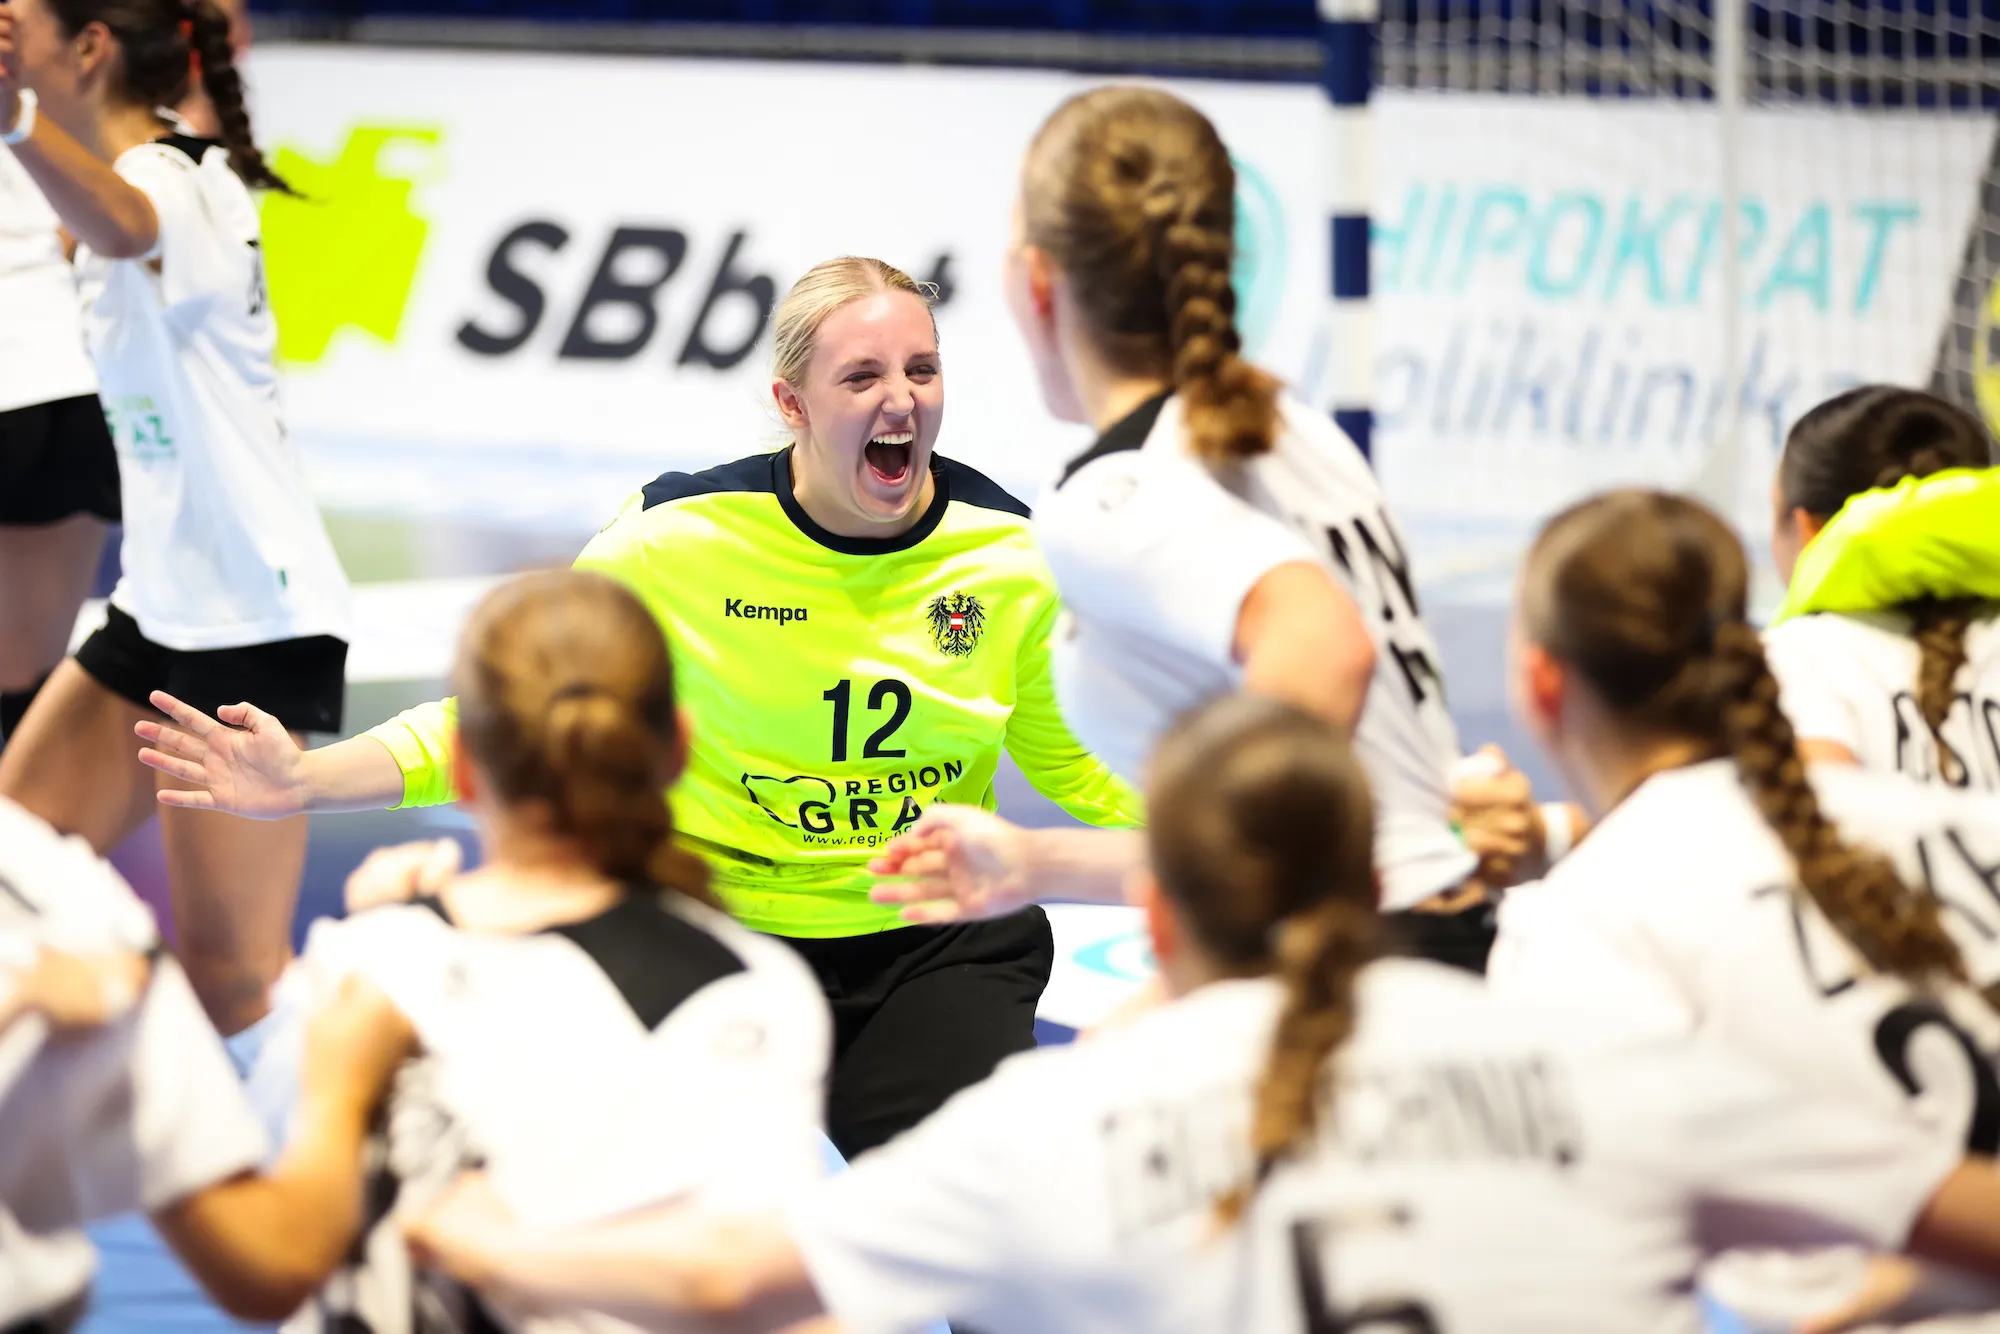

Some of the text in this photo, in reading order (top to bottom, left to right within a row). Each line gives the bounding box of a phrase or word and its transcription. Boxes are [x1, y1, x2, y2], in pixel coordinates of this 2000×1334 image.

[455, 218, 958, 371] SBb
[725, 598, 808, 626] Kempa
[823, 679, 912, 762] 12
[845, 760, 963, 796] REGION
[798, 793, 947, 834] GRA
